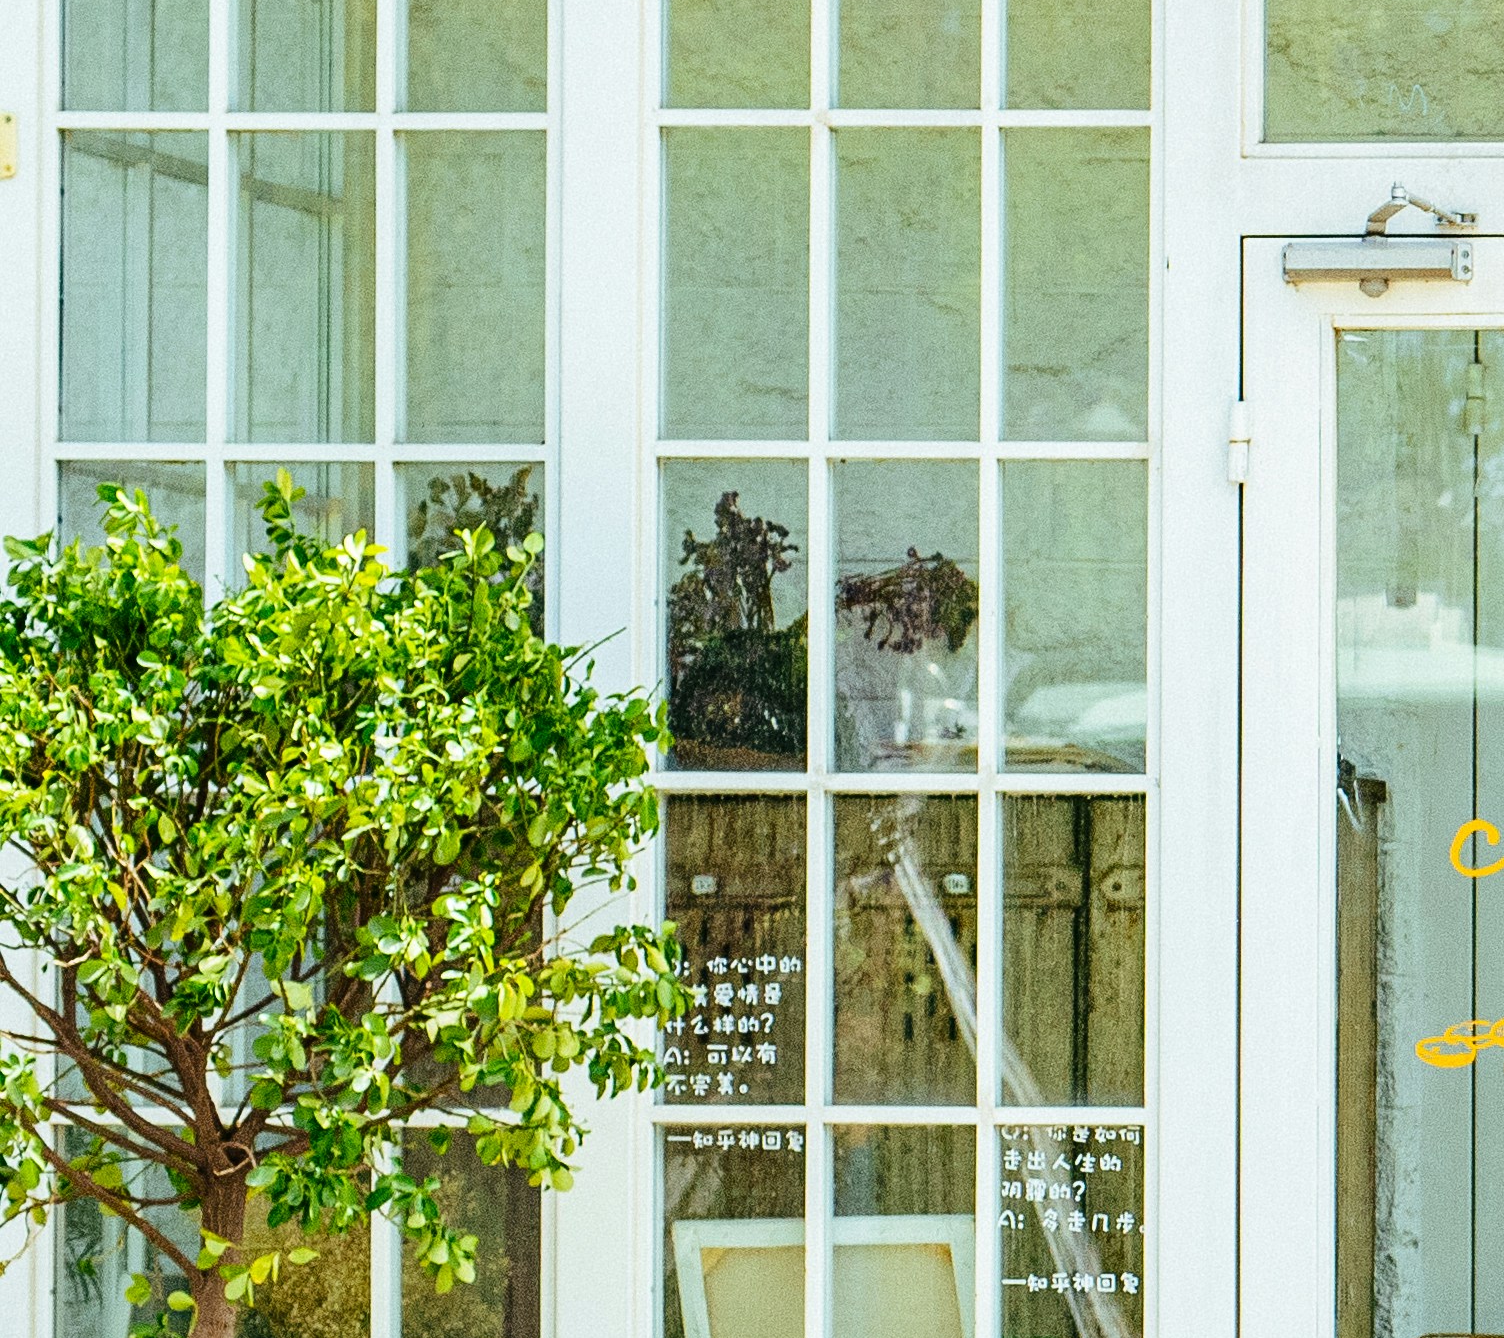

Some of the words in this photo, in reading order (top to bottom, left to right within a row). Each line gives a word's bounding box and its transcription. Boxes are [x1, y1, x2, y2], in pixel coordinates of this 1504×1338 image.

[1003, 1148, 1123, 1174] 走出人生的
